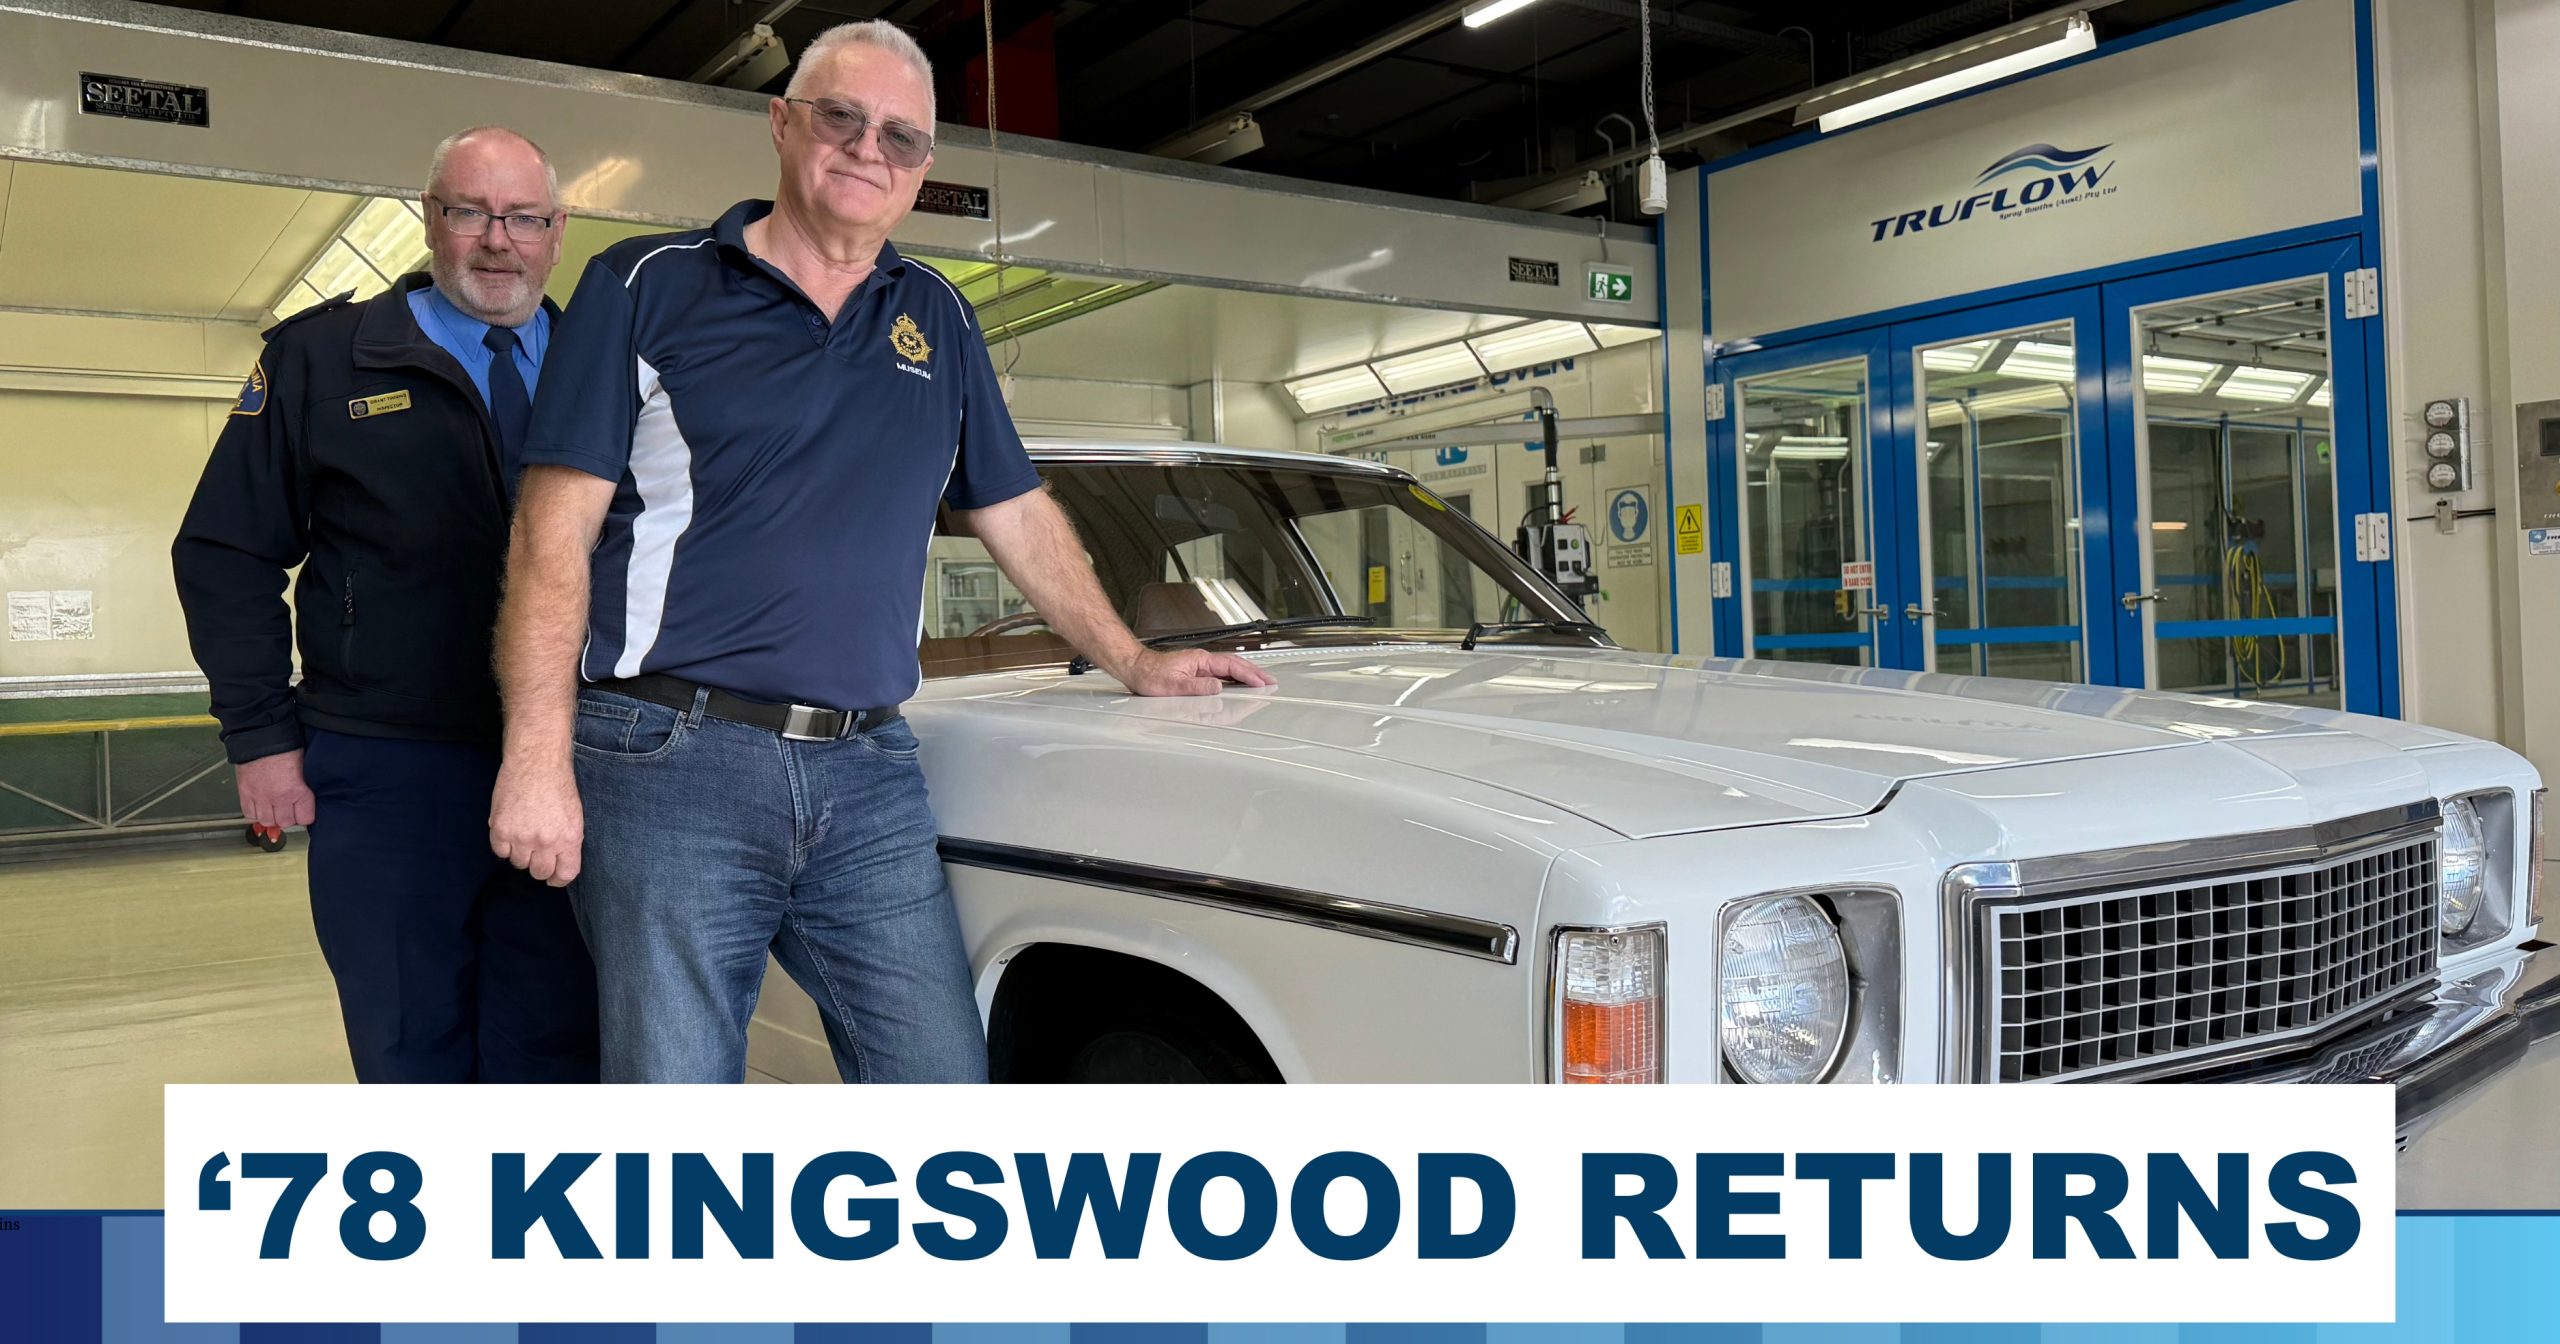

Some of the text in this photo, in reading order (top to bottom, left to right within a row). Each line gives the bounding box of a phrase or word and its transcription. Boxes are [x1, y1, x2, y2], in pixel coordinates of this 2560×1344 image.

[86, 81, 201, 115] SEETAL
[1871, 160, 2116, 242] TRUFLOW
[1999, 210, 2022, 220] Spray
[2084, 190, 2100, 199] Pty
[2103, 186, 2118, 195] Ltd
[1511, 261, 1557, 280] SEETAL
[896, 362, 931, 380] MUSEUM
